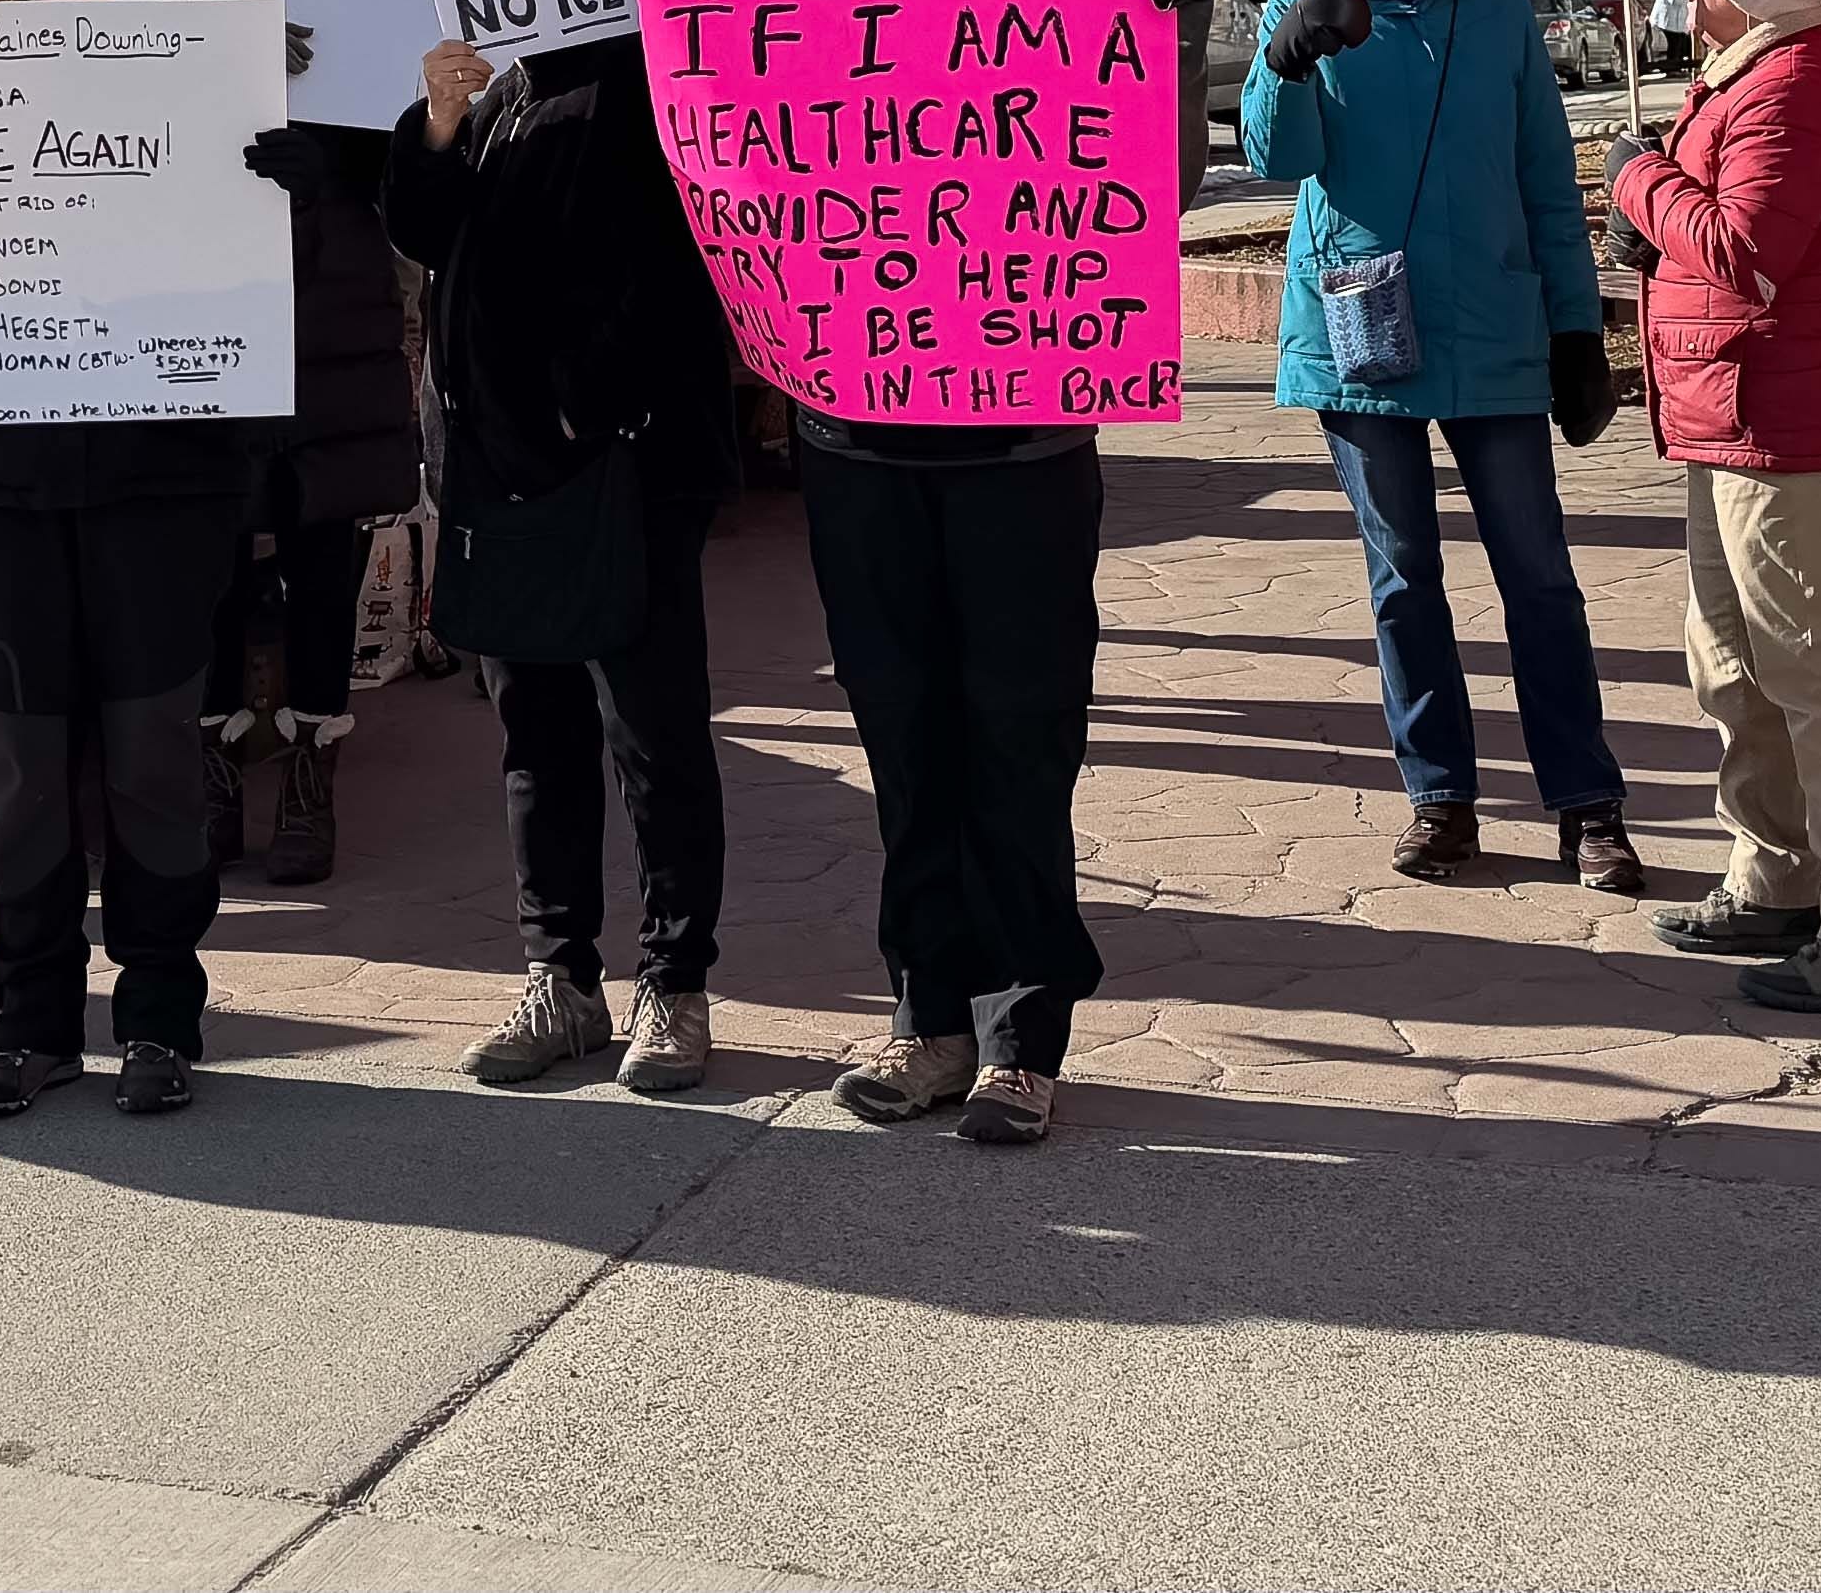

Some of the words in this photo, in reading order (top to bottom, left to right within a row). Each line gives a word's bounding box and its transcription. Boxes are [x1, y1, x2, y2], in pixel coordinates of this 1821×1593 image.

[663, 3, 802, 78] IF
[849, 3, 903, 79] I
[948, 2, 1071, 72] AM
[1097, 11, 1146, 85] A
[31, 120, 172, 170] AGAIN!
[667, 87, 1114, 174] HEALTHCARE
[17, 196, 55, 210] RID
[687, 179, 970, 247] PROVIDER
[1004, 179, 1148, 241] AND
[704, 244, 788, 305] TRY
[819, 246, 918, 296] TO
[211, 335, 247, 350] the
[796, 302, 833, 362] I
[865, 306, 939, 357] BE
[979, 297, 1148, 351] SHOT
[41, 403, 62, 421] in
[68, 402, 100, 417] the
[106, 402, 160, 416] White
[164, 402, 228, 416] House
[864, 363, 913, 412] IN
[927, 365, 1034, 413] THE
